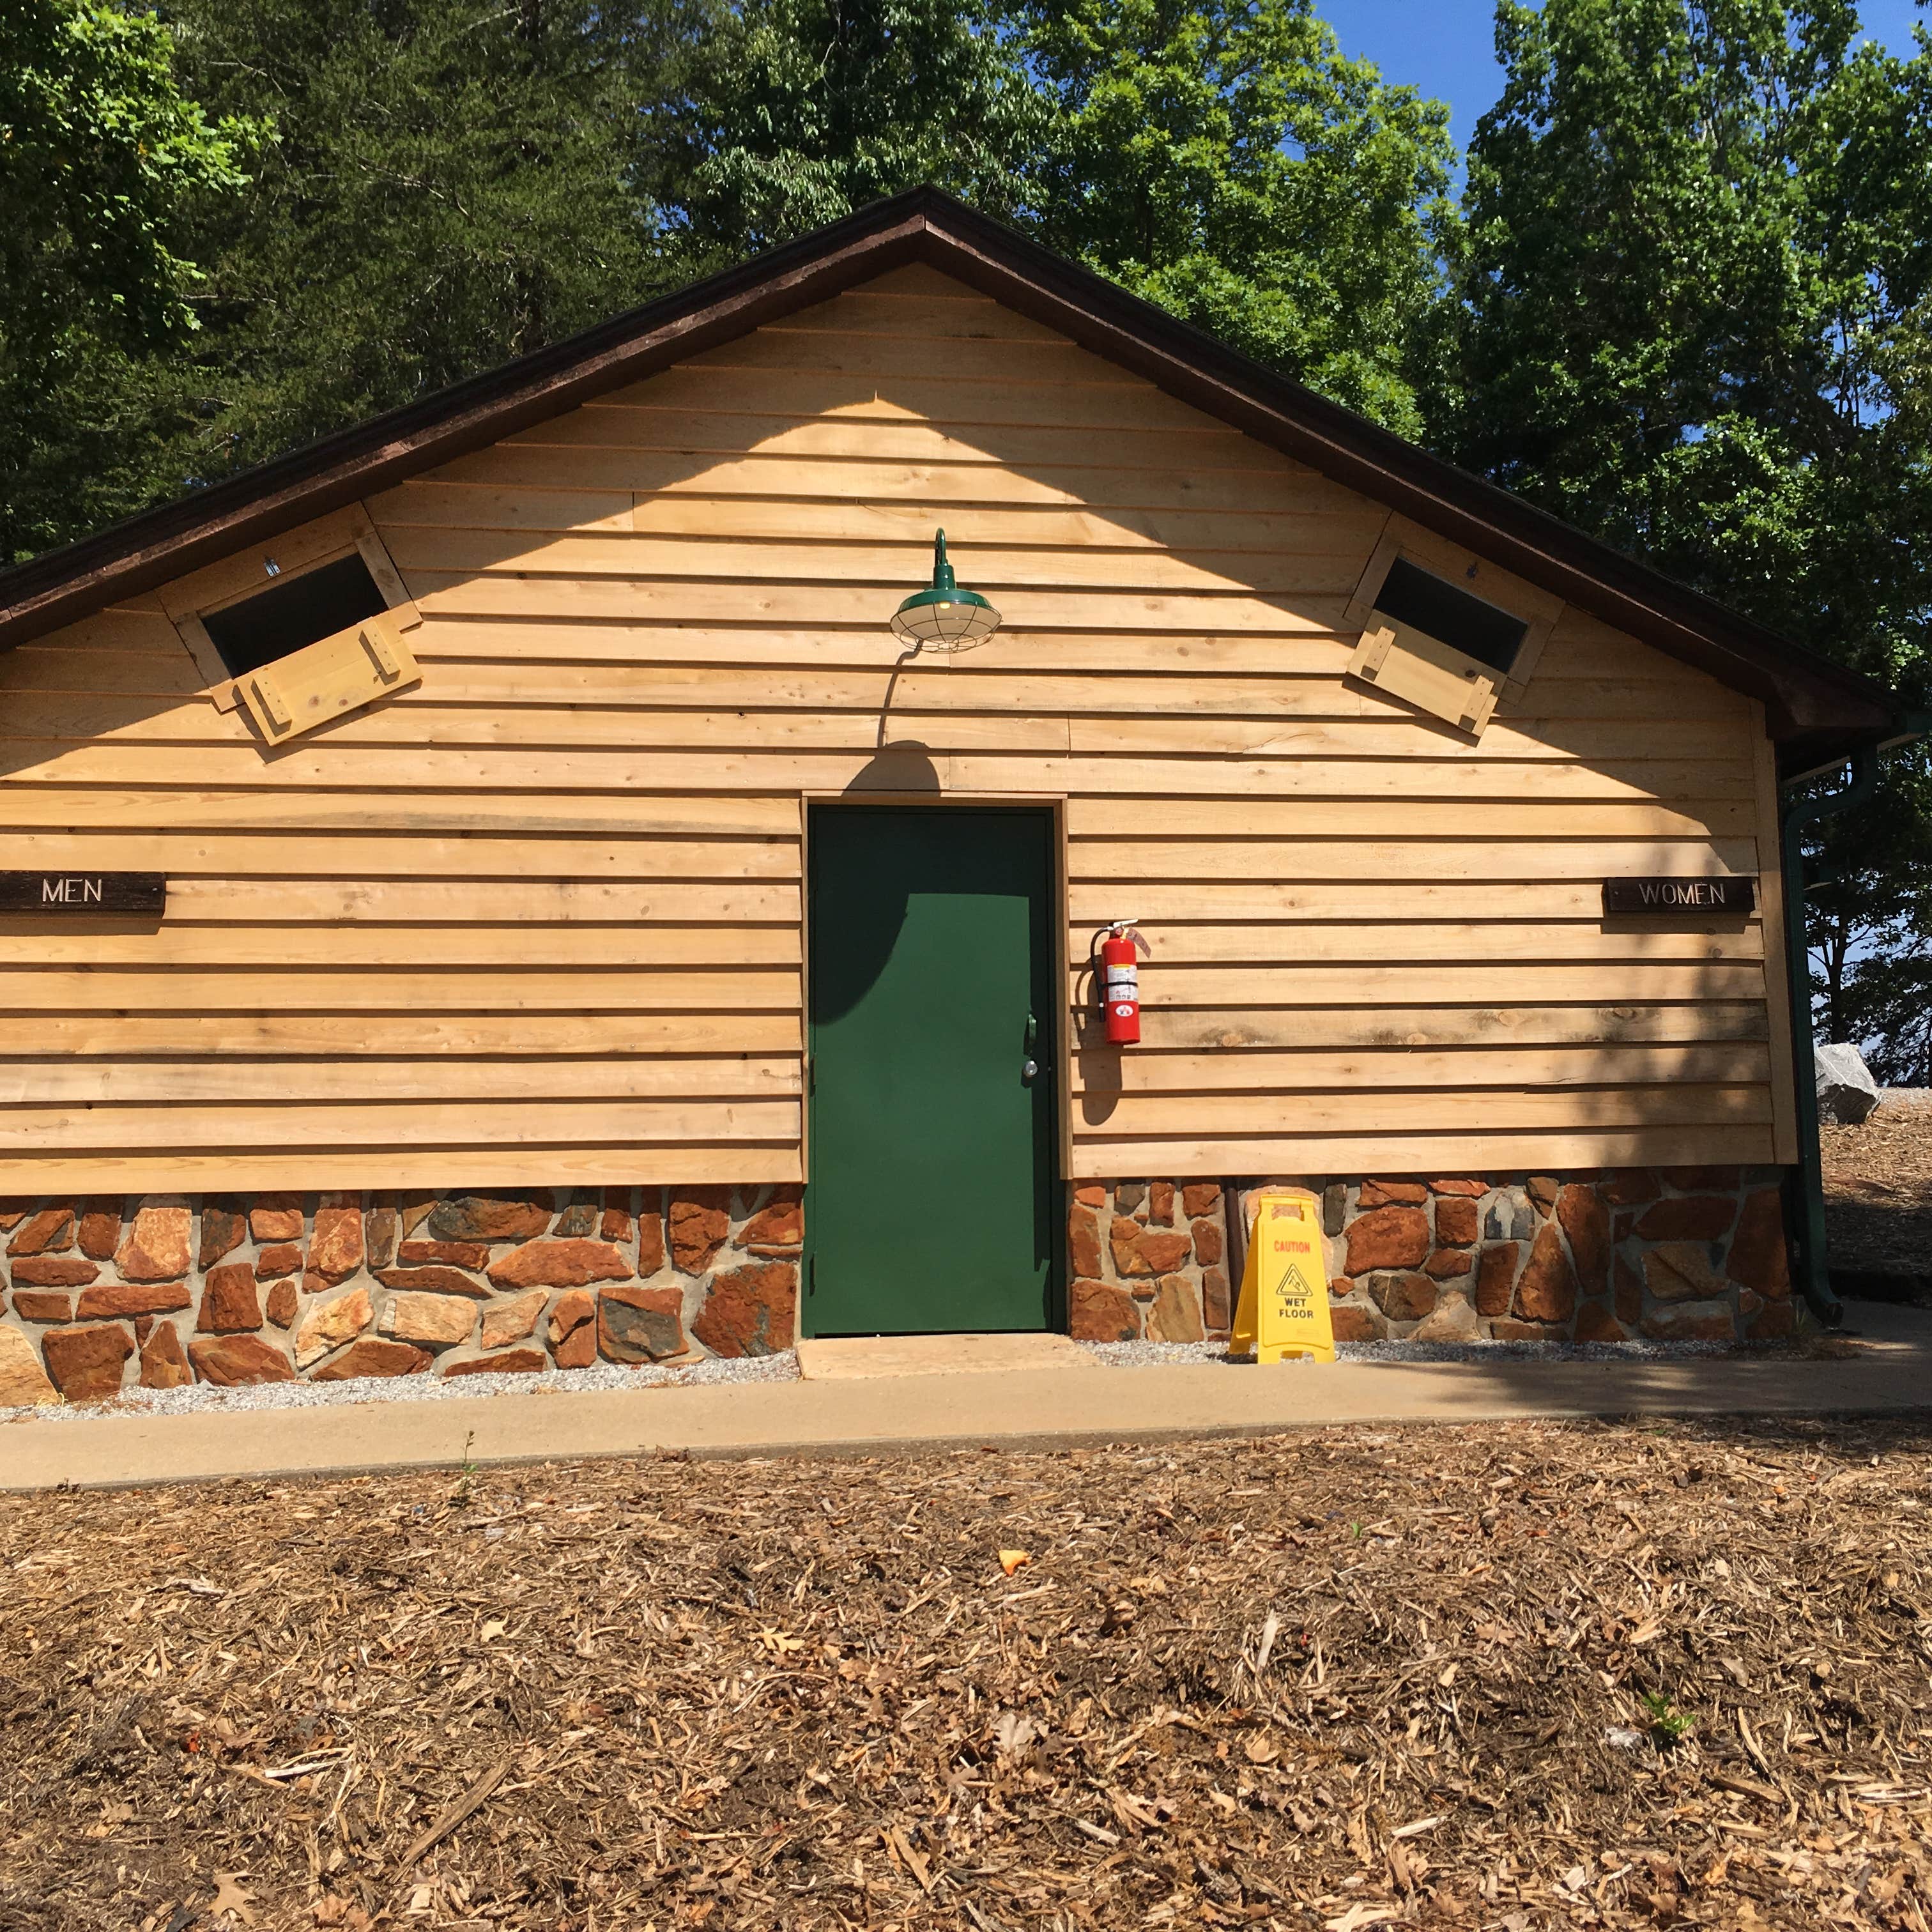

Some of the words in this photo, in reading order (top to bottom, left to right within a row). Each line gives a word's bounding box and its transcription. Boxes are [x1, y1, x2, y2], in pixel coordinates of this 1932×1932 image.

[42, 878, 102, 902] MEN
[1638, 883, 1726, 905] WOMEN
[1274, 1240, 1310, 1254] CAUTION
[1284, 1298, 1307, 1307] WET
[1279, 1309, 1314, 1319] FLOOR
